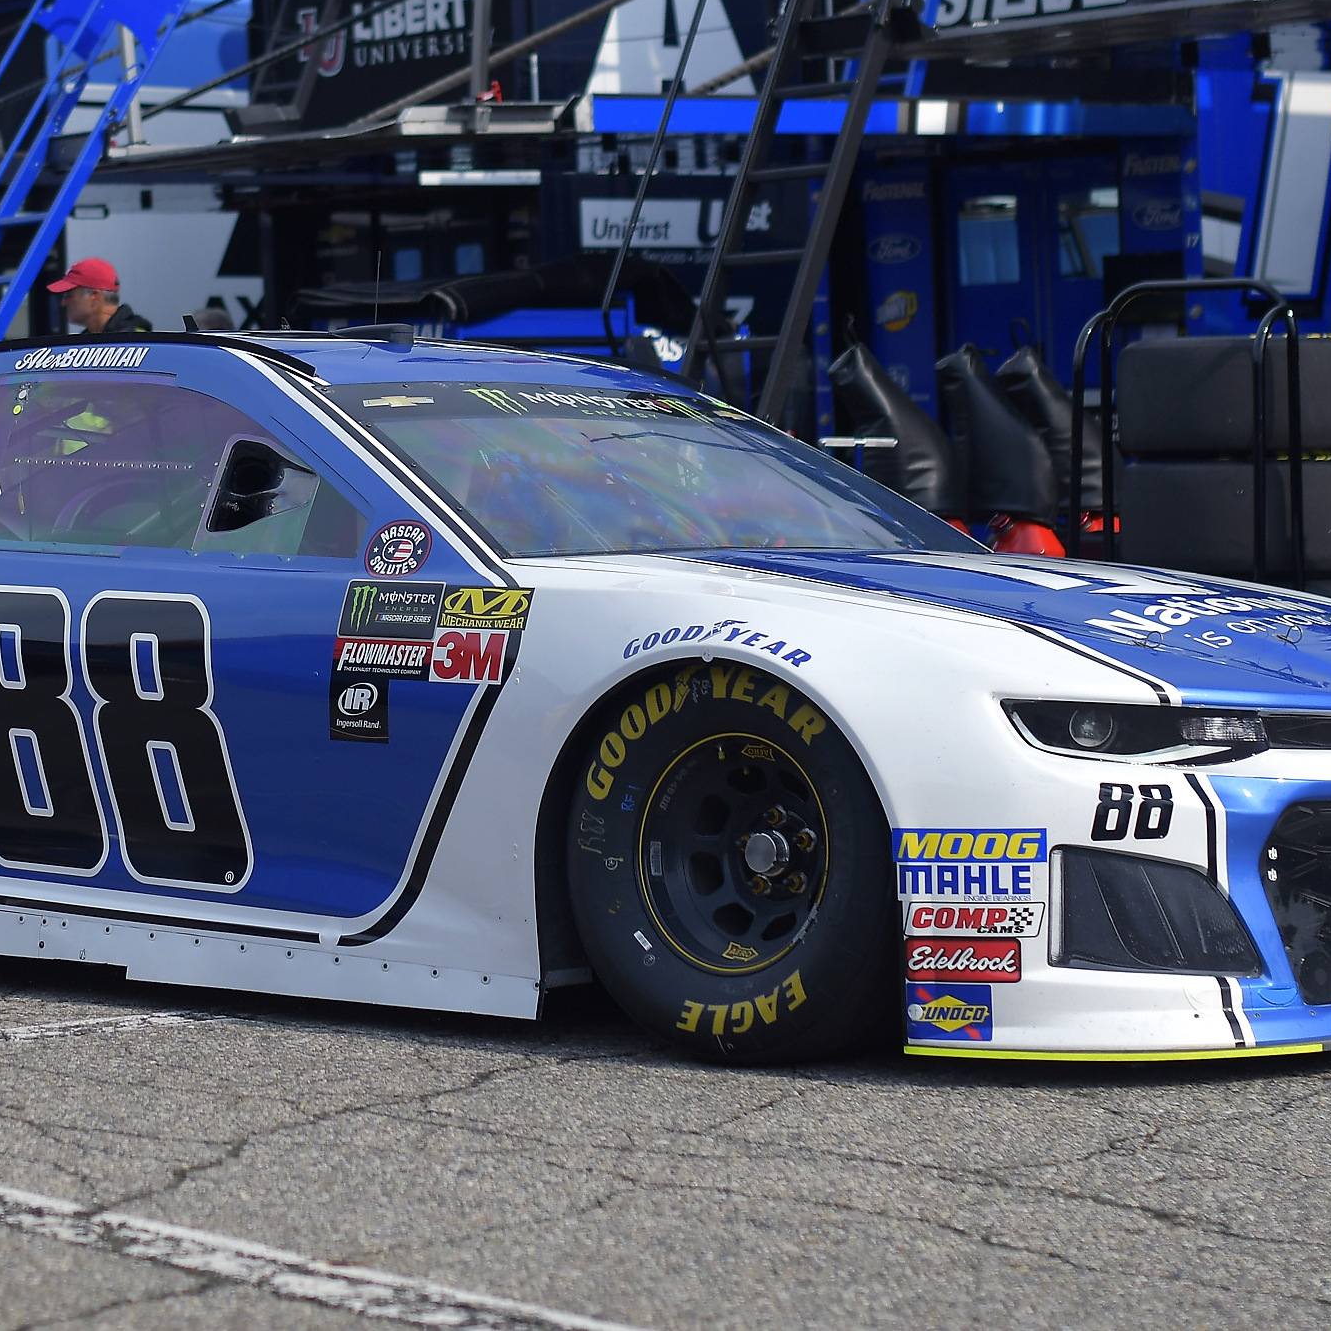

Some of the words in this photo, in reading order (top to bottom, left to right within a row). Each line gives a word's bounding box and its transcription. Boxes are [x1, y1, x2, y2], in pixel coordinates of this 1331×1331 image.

[354, 25, 495, 68] UNIVERSI
[15, 347, 64, 371] Alex
[62, 347, 150, 368] BOWMAN
[519, 390, 673, 414] MONSTER
[581, 409, 659, 419] ENERGY
[379, 524, 427, 546] NASCAR
[369, 556, 418, 576] SALUTES
[378, 590, 437, 606] MONSTER
[380, 614, 402, 623] NASCAR
[401, 614, 413, 623] CUP
[412, 615, 433, 624] SERIES
[439, 613, 493, 629] MECHANIX
[493, 617, 525, 630] WEAR
[621, 619, 814, 669] GOODYEAR
[1183, 629, 1234, 650] is
[336, 642, 429, 672] FLOWMASTER
[433, 630, 507, 682] 3M
[371, 667, 401, 675] TECHNOLOGY
[400, 668, 422, 676] COMPANY
[343, 686, 373, 711] IR
[335, 718, 363, 729] Ingersoll
[362, 719, 381, 730] Rand
[585, 665, 827, 801] GOODYEAR
[1090, 781, 1174, 842] 88
[898, 831, 1042, 860] MOOG
[898, 864, 1032, 895] MAHLE
[912, 906, 1009, 929] COMP
[976, 925, 1025, 934] CAMS
[731, 947, 754, 959] AERO
[907, 945, 1018, 973] Edelbrock
[675, 969, 808, 1036] EAGLE
